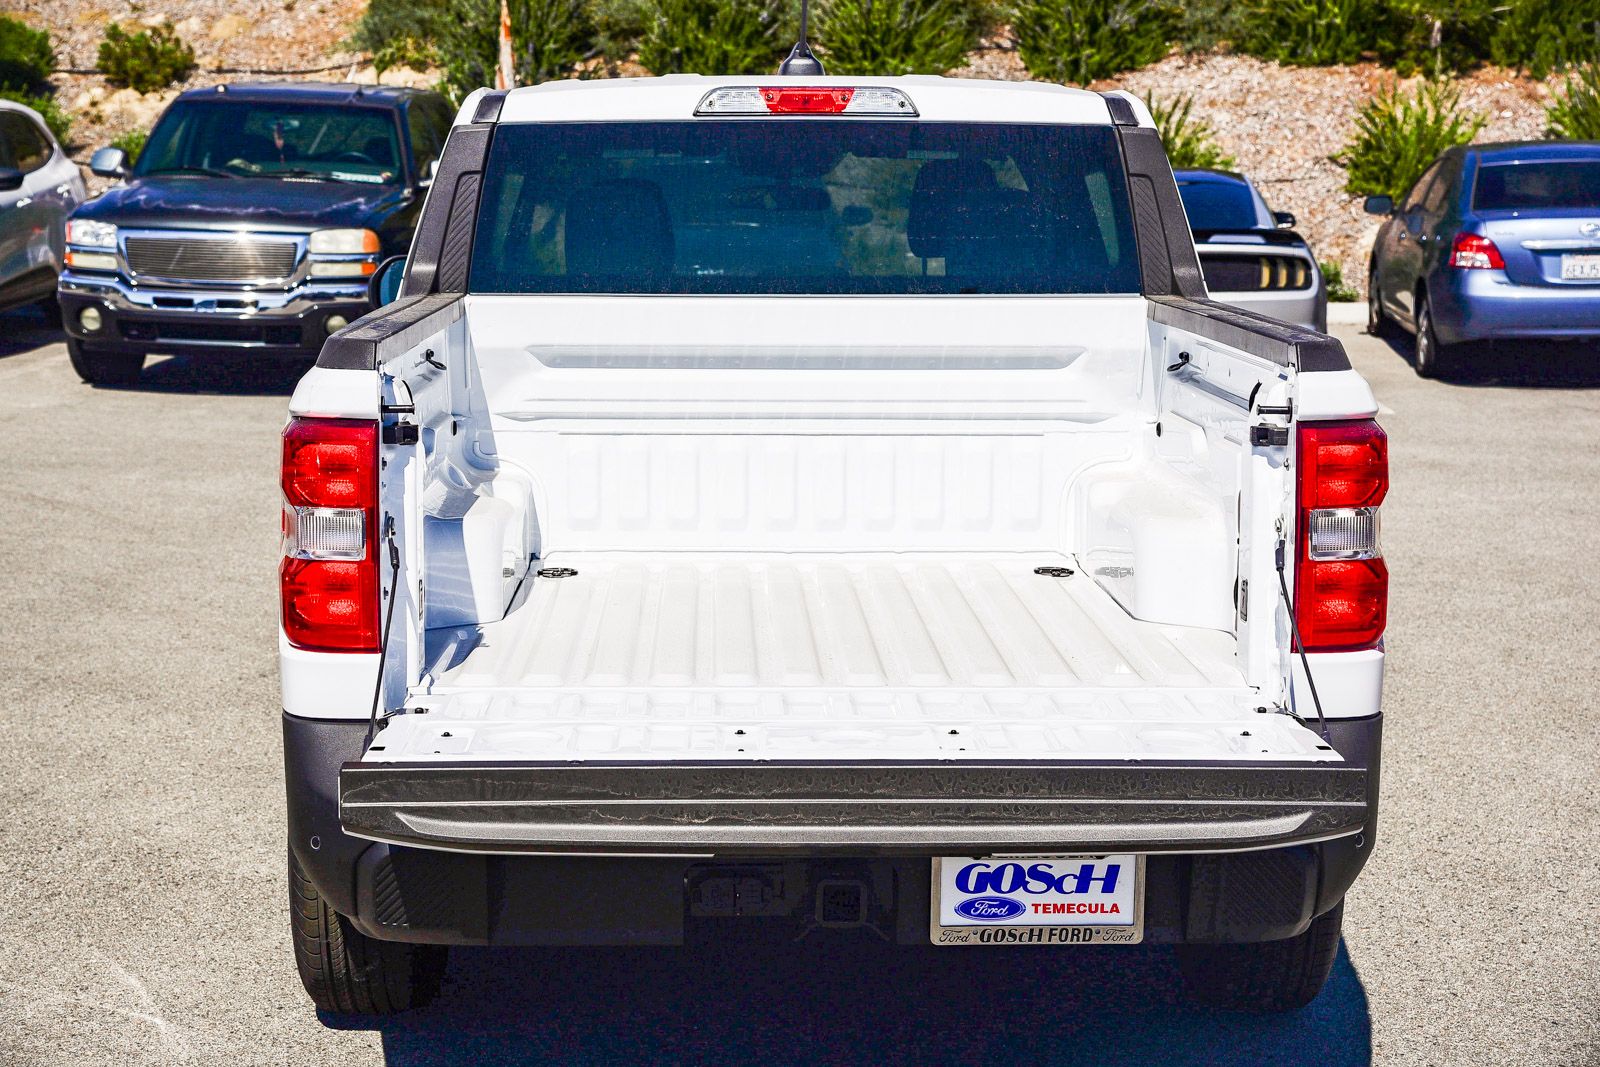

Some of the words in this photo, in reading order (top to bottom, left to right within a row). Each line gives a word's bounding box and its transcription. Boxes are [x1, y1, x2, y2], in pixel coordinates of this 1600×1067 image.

[970, 901, 1009, 916] Ford
[1031, 903, 1121, 914] TEMECULA
[939, 930, 970, 943] Ford
[1048, 928, 1093, 943] FORD
[1102, 929, 1135, 942] Ford
